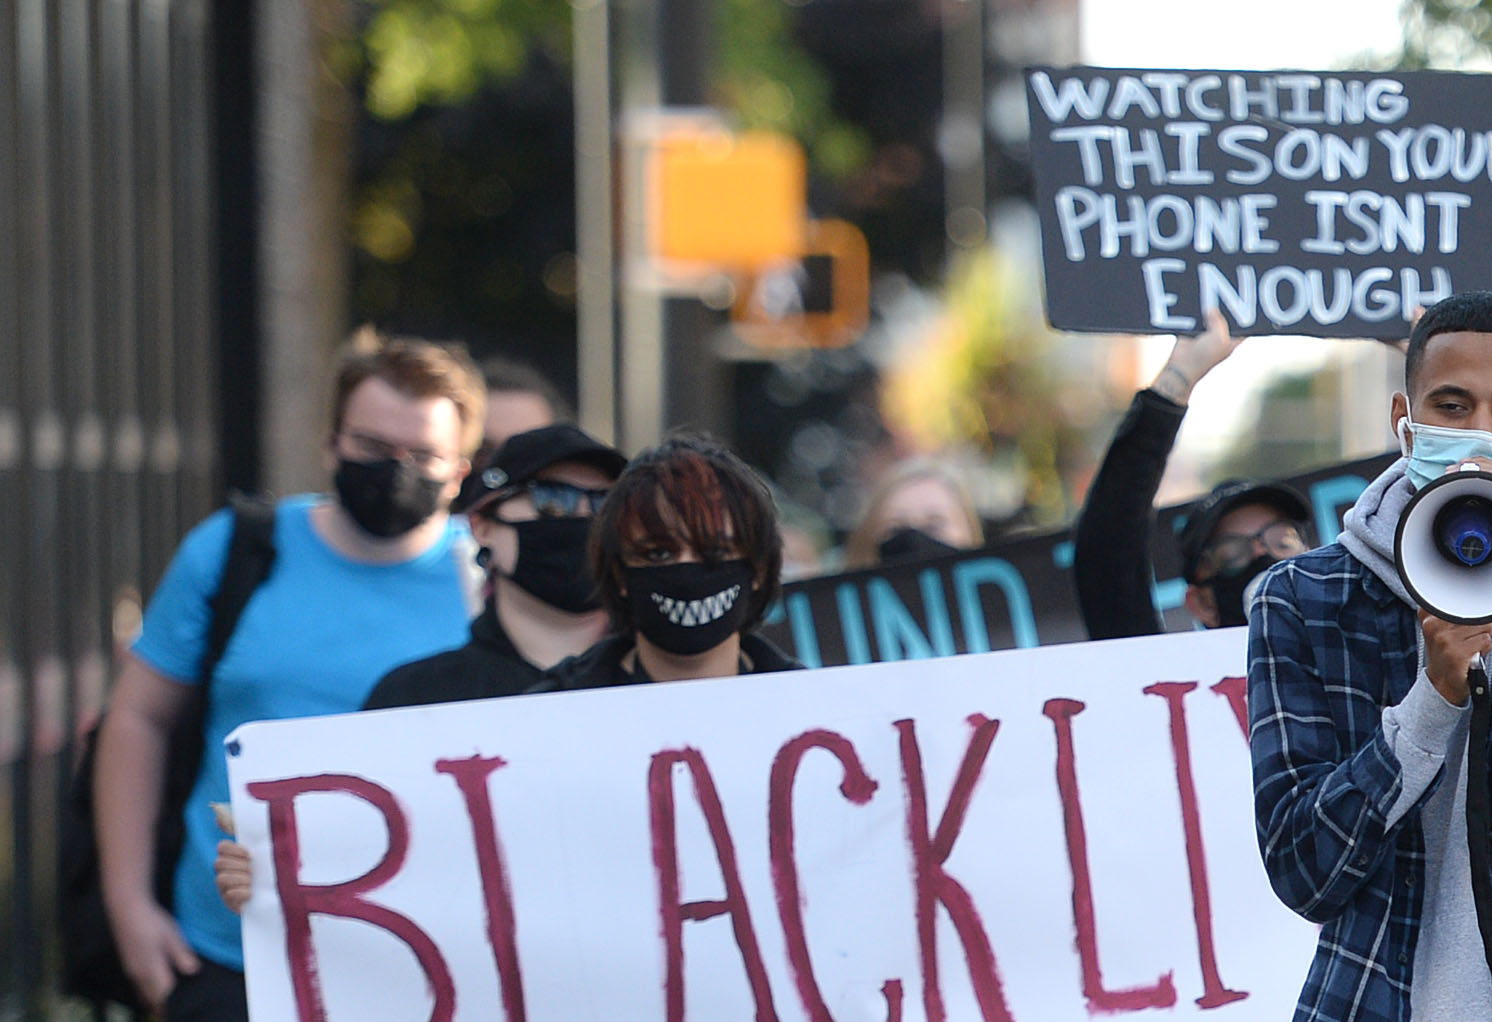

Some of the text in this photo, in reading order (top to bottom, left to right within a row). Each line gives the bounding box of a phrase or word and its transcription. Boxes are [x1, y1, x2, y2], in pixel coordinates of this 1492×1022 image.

[1029, 70, 1409, 124] WATCHING
[1054, 186, 1472, 261] PHONE ISNT
[1141, 258, 1453, 330] ENOUGH
